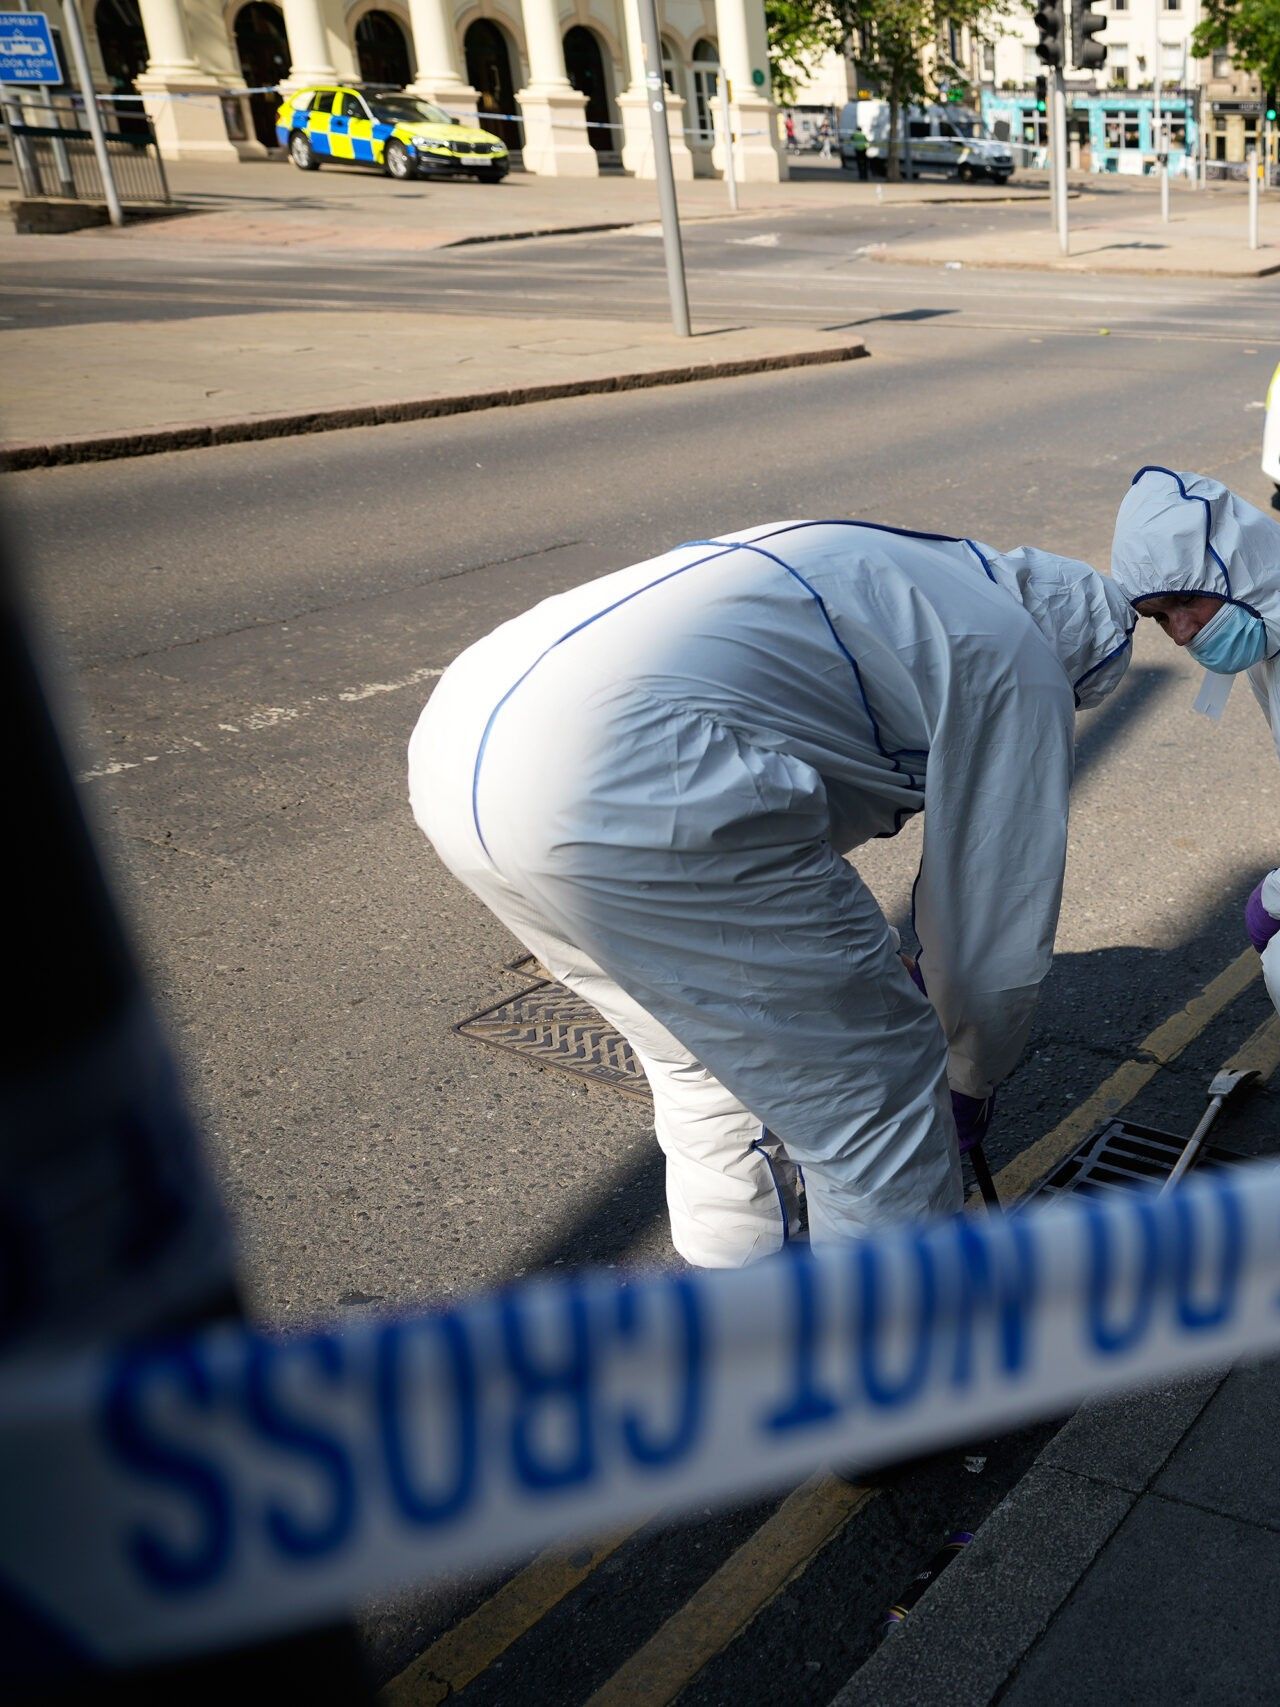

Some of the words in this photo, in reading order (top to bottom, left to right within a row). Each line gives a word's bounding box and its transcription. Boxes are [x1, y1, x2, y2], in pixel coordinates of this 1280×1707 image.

[758, 1213, 1037, 1431] NOT
[1082, 1180, 1244, 1358] DO
[100, 1276, 707, 1592] CROSS
